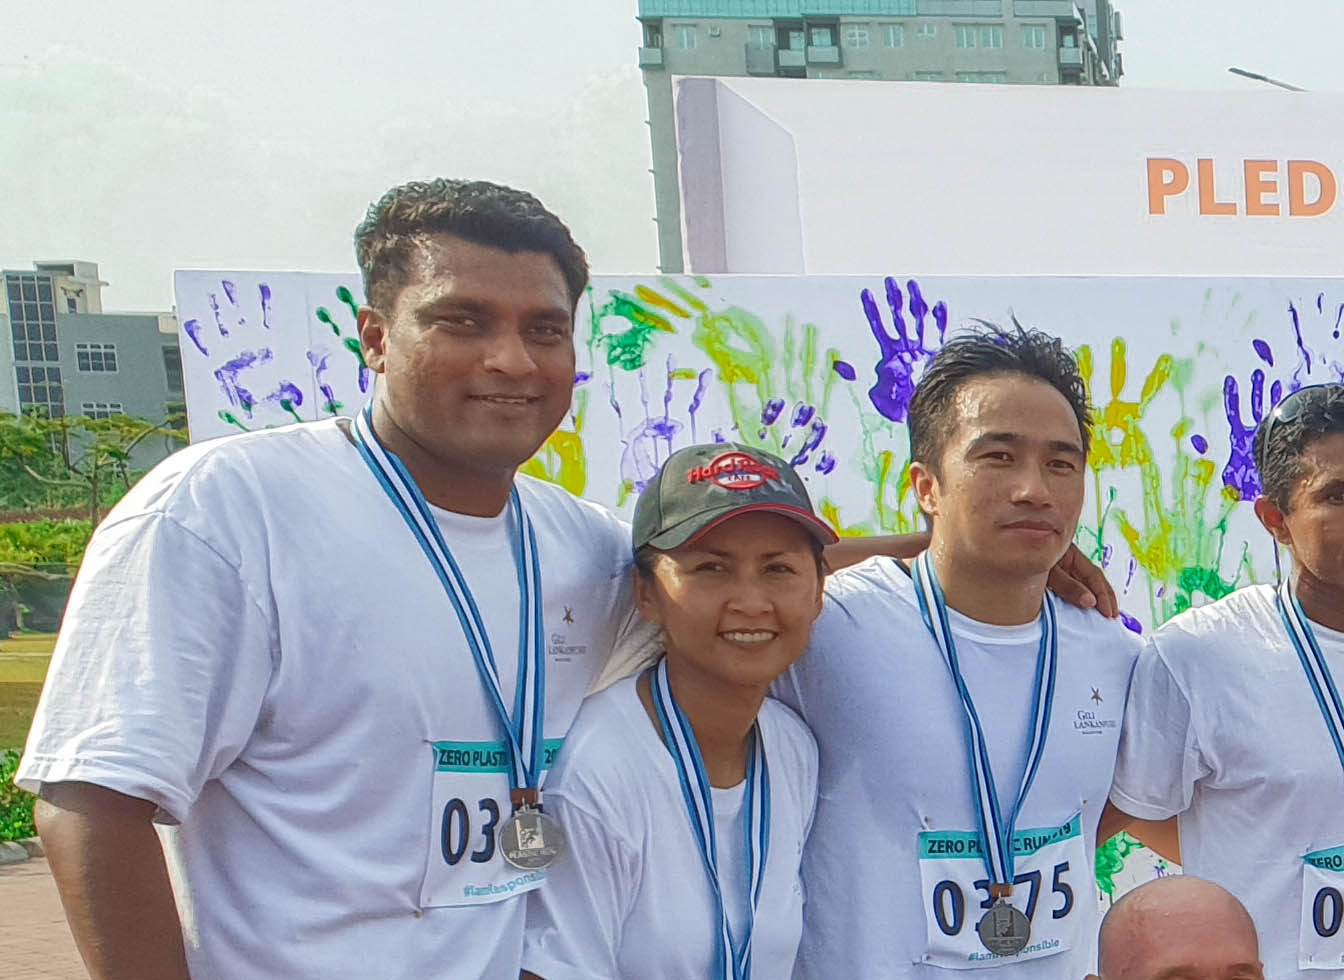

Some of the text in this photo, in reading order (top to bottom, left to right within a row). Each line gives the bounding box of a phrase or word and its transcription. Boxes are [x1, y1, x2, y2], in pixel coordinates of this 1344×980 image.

[438, 748, 470, 766] ZERO
[473, 750, 505, 767] PLAST
[440, 797, 500, 866] 03
[927, 839, 965, 854] ZERO
